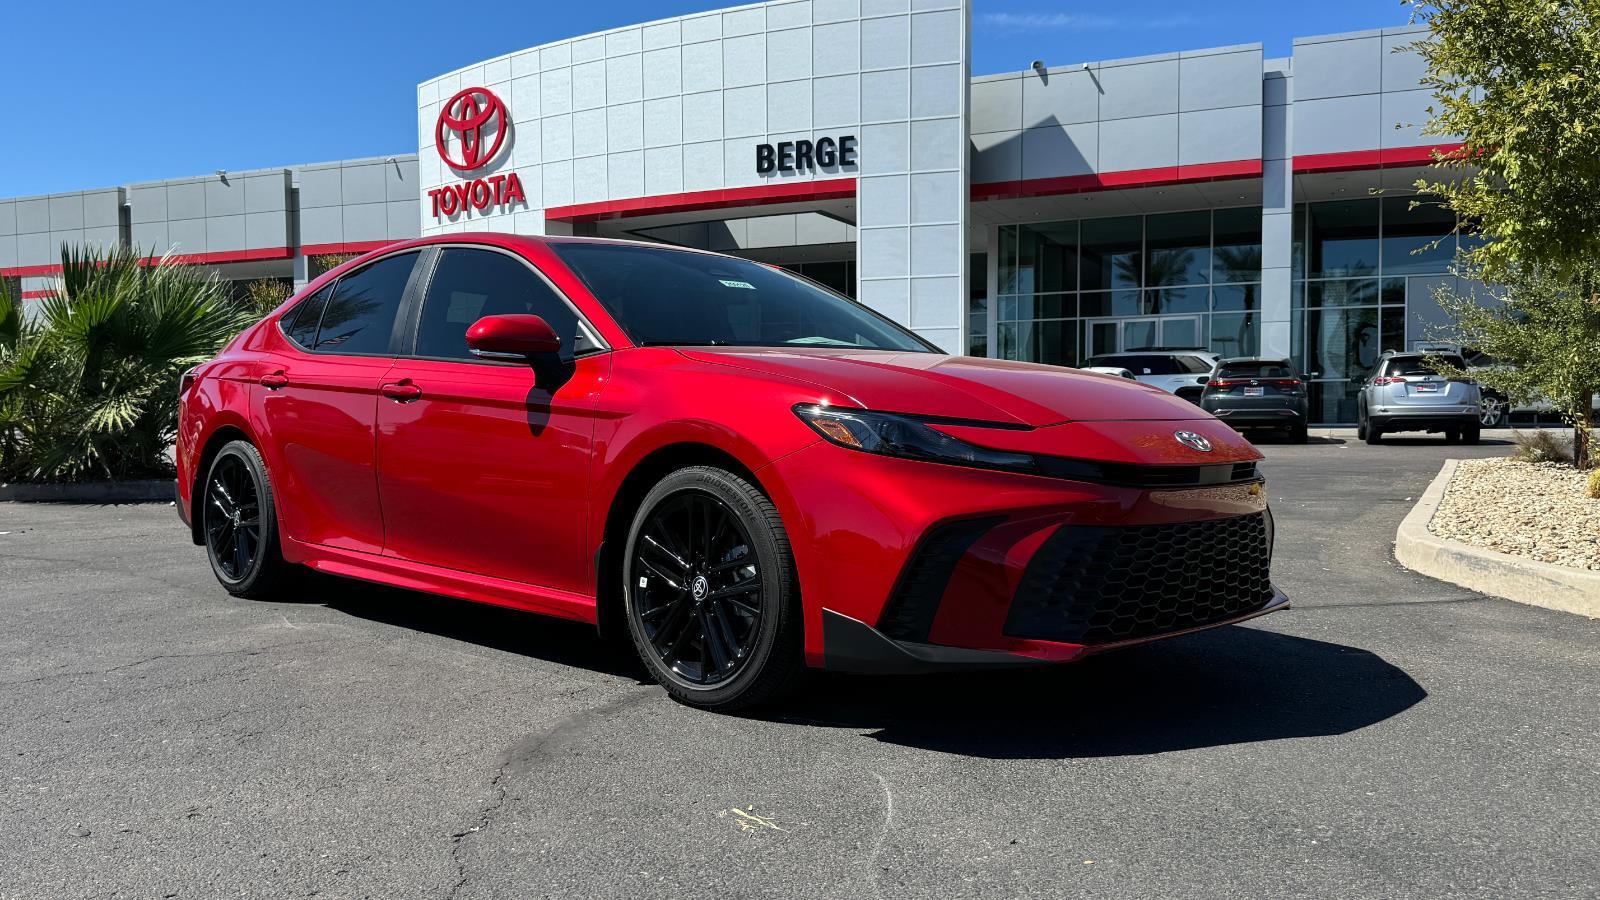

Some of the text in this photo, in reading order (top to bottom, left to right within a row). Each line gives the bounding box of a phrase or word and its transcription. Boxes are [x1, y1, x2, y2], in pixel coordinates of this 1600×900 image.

[756, 135, 856, 173] BERGE
[428, 172, 524, 218] TOYOTA
[696, 474, 758, 523] BRIDGESTONE
